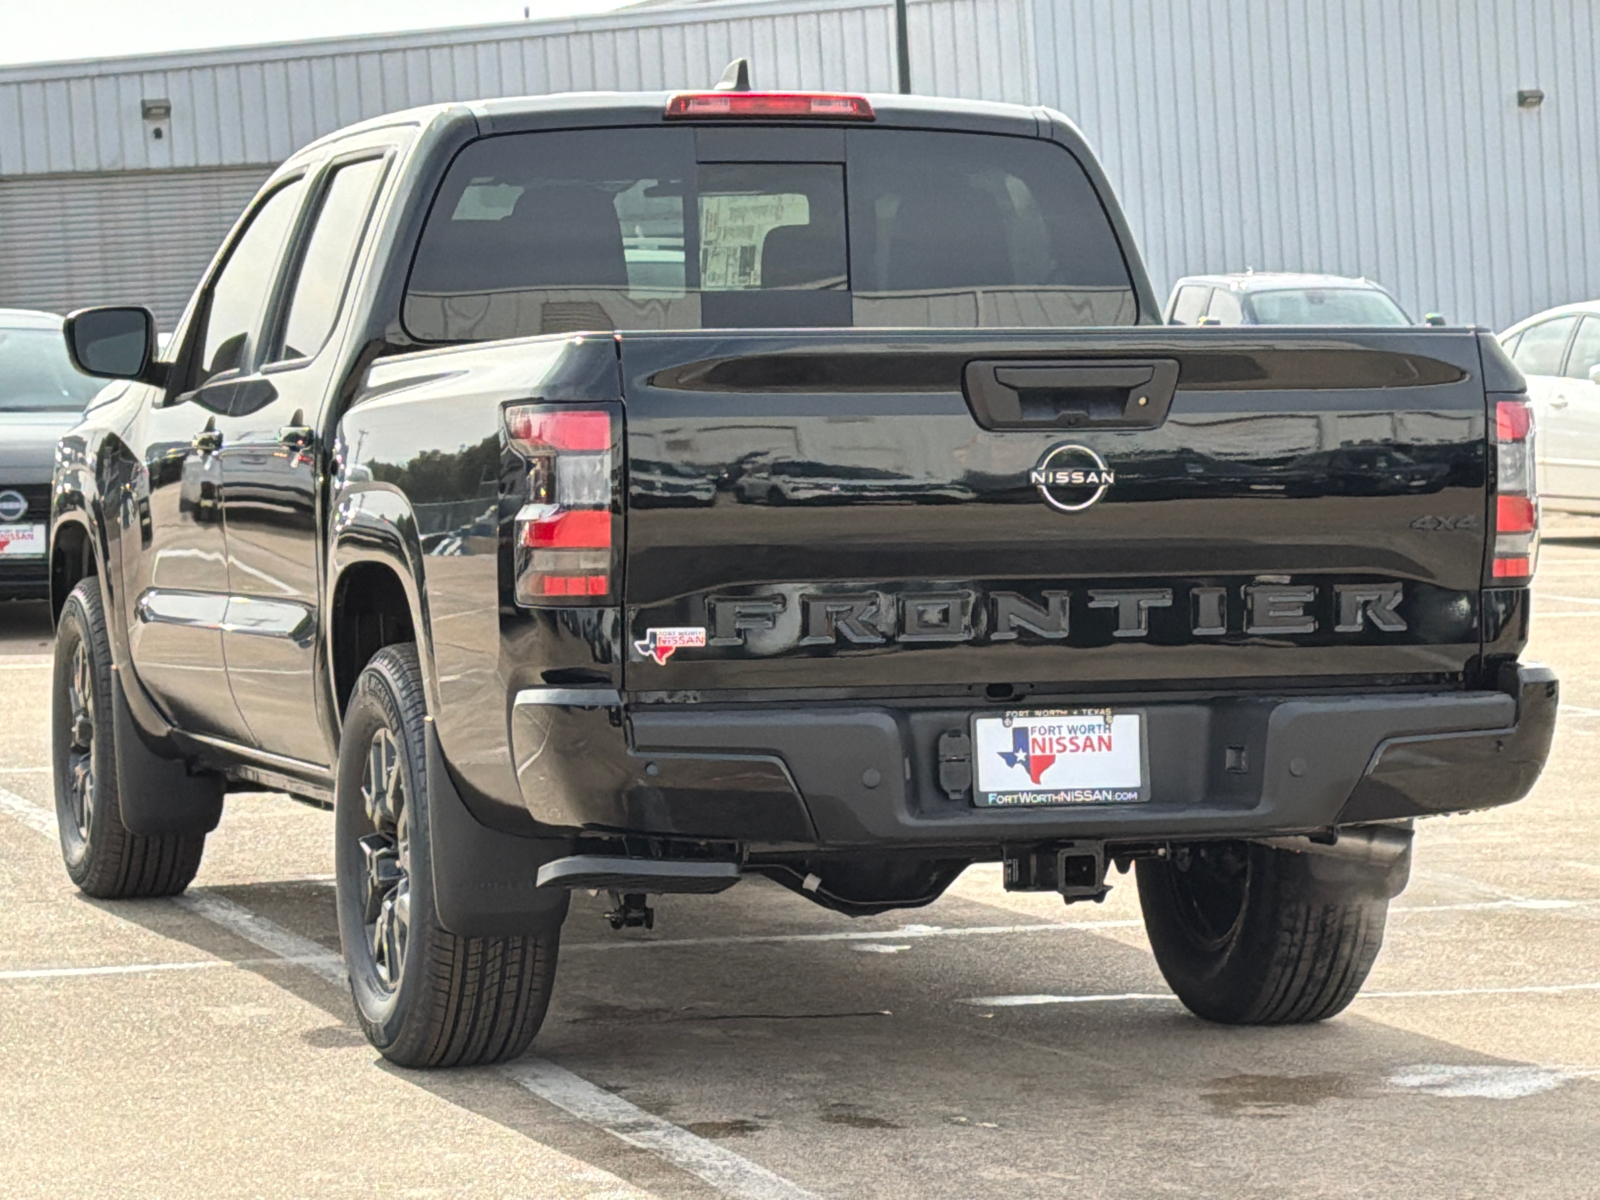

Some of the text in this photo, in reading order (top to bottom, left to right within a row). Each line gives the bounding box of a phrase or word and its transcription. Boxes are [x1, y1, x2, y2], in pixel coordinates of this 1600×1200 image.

[1031, 471, 1114, 484] NISSAN
[707, 583, 1408, 646] FRONTIER
[658, 636, 705, 645] NISSAN
[1005, 710, 1029, 718] FORT
[1081, 708, 1112, 716] TEXAS
[1030, 724, 1112, 736] FORT WORTH
[1031, 735, 1112, 754] NISSAN
